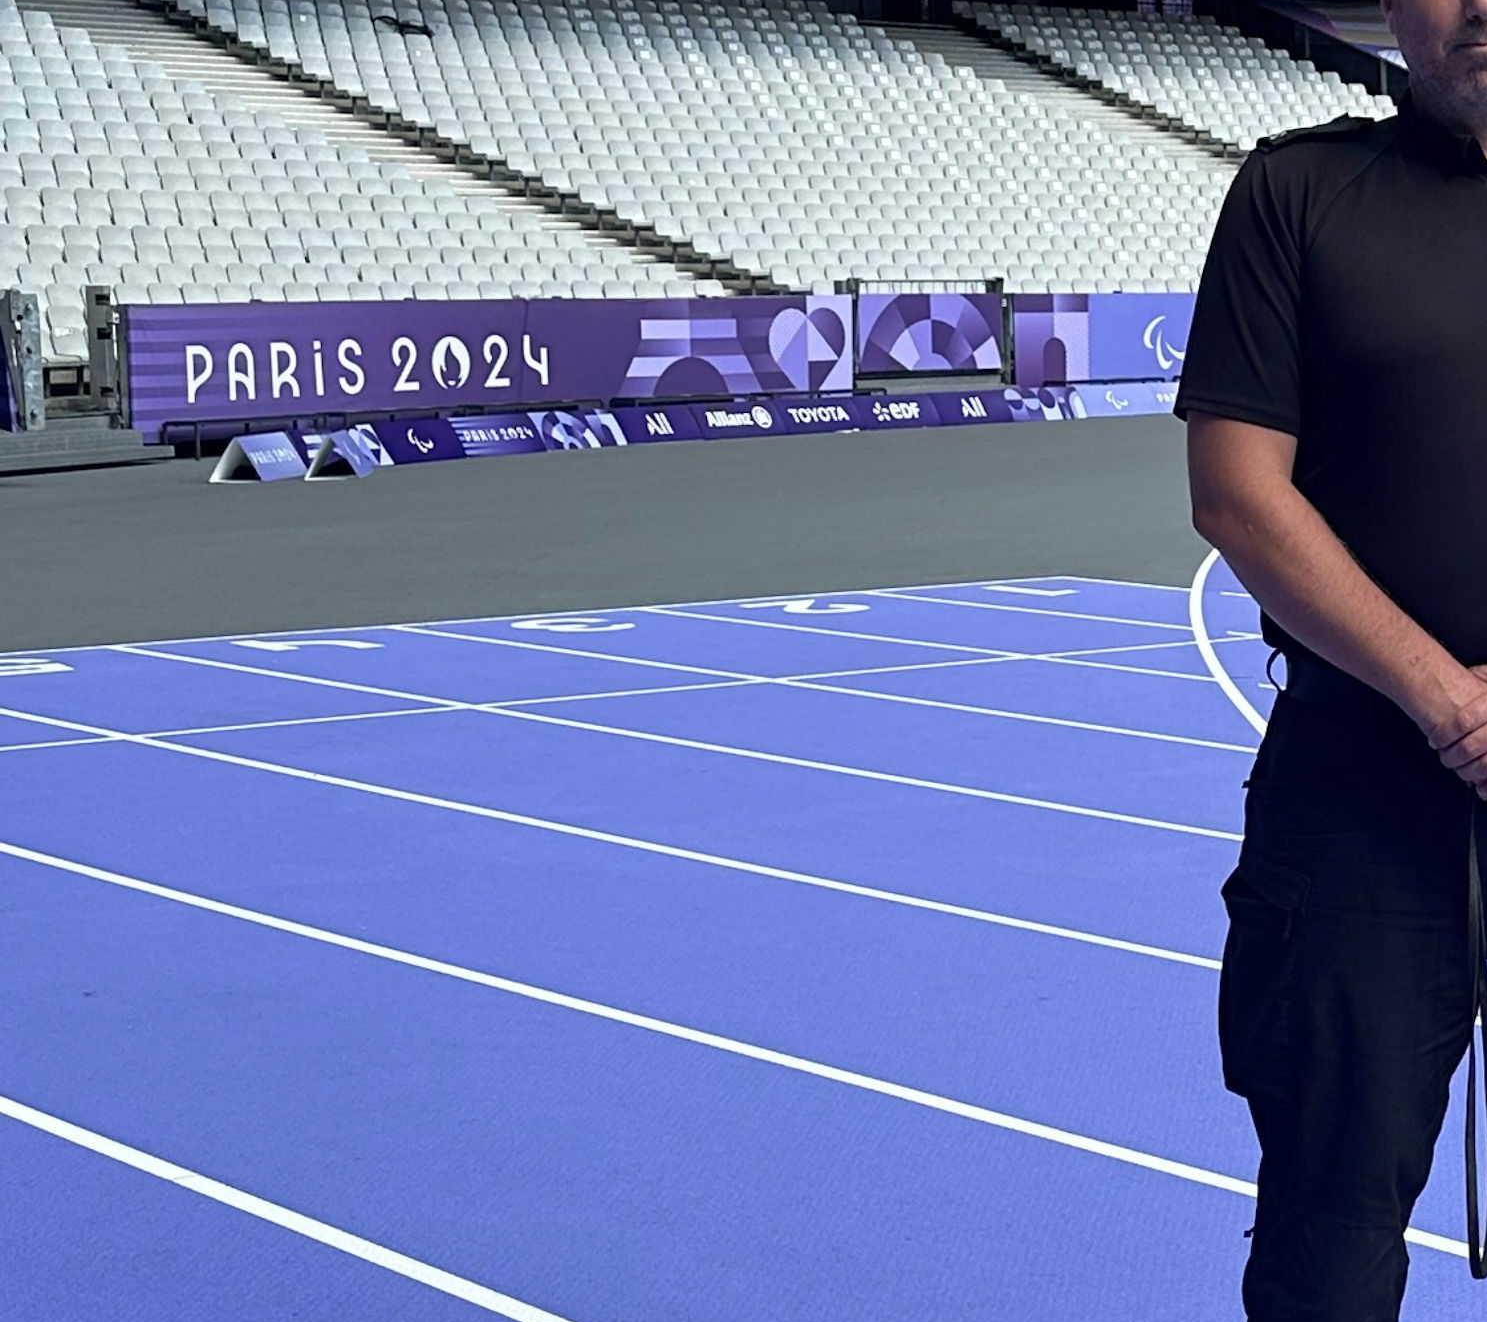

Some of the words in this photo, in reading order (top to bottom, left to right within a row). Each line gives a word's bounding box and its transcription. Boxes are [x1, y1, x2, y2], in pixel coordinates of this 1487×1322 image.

[391, 333, 550, 393] 2024
[705, 410, 754, 428] Allianz
[787, 405, 850, 424] TOYOTA
[500, 425, 535, 442] 2024
